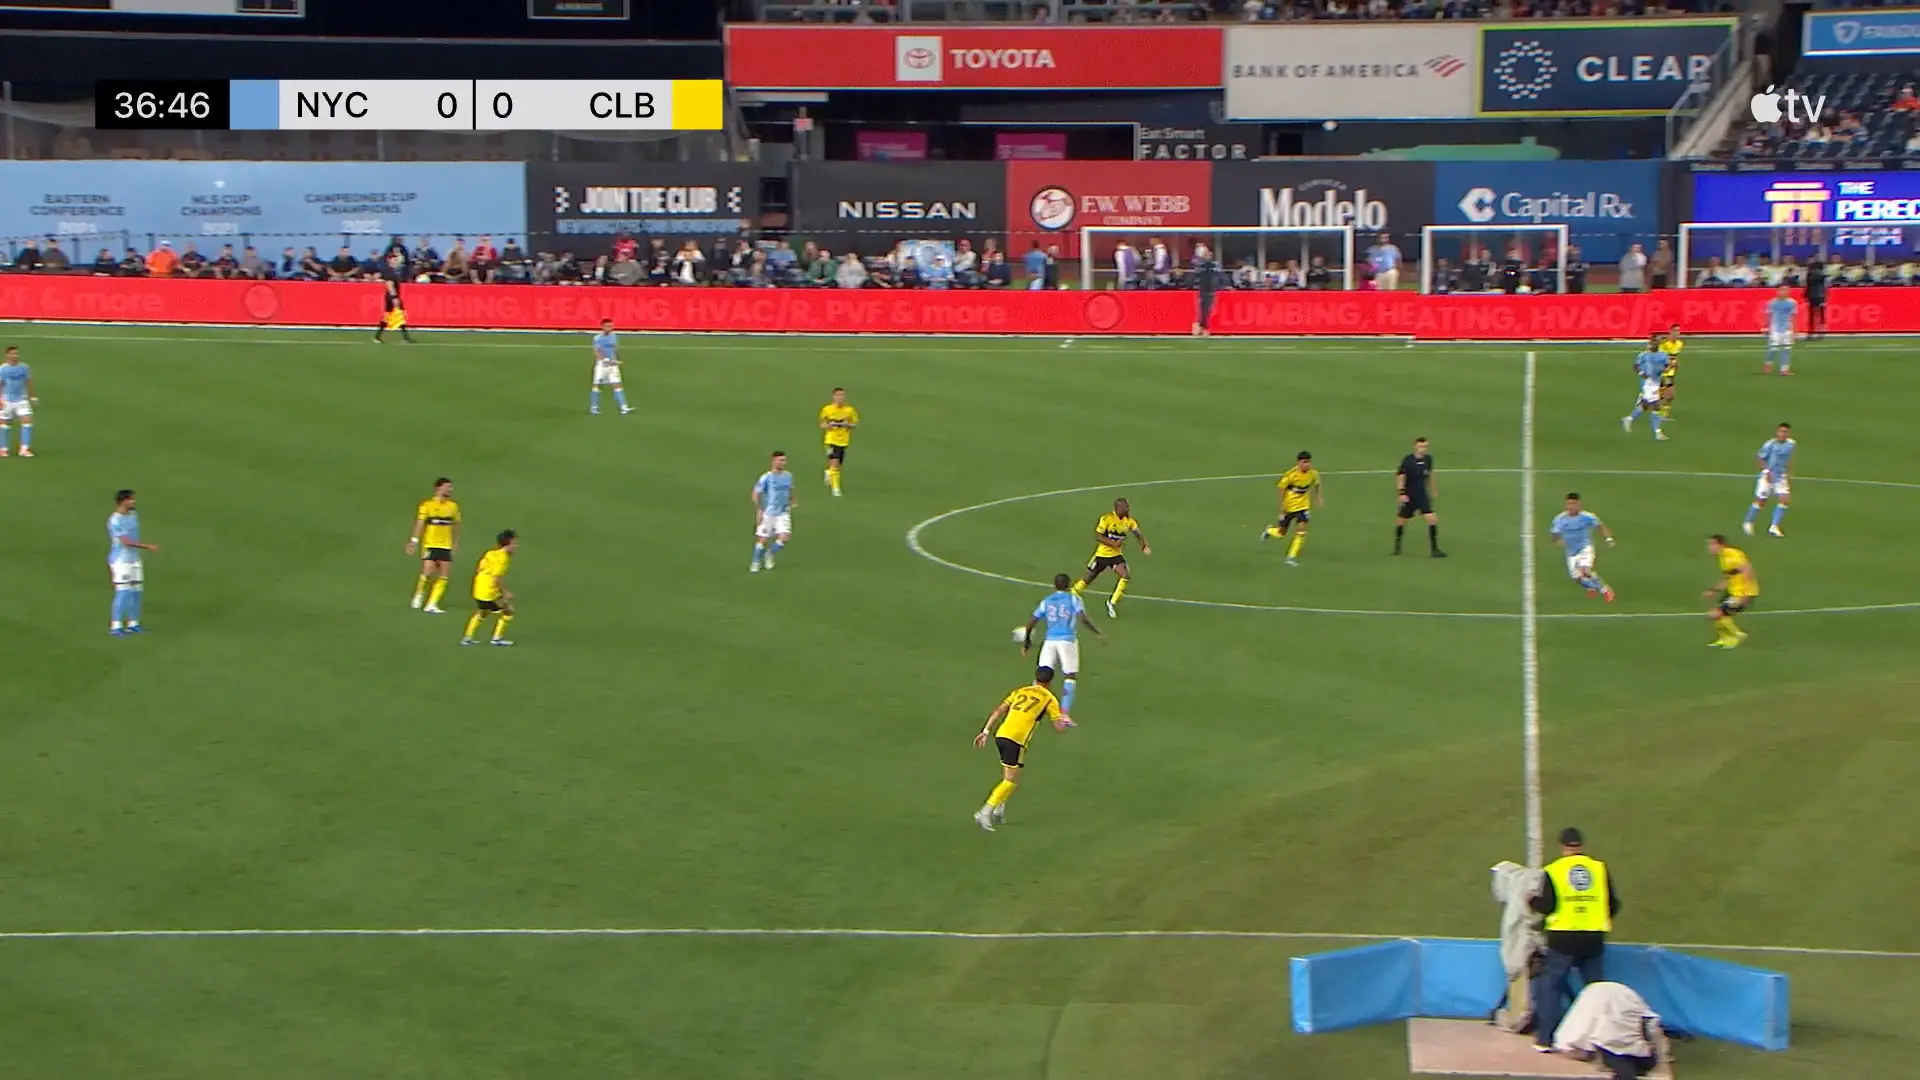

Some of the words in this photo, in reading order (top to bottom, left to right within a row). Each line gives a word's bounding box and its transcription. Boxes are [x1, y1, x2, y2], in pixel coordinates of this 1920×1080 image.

[950, 48, 1056, 69] TOYOTA
[1232, 63, 1291, 80] BANK
[1295, 63, 1322, 79] OF
[1324, 62, 1419, 79] AMERICA
[1141, 143, 1247, 160] FACTOR
[391, 192, 417, 202] CUP
[1837, 181, 1876, 195] THE
[44, 194, 110, 204] EASTERN
[580, 186, 628, 213] JOIN
[630, 187, 666, 213] THE
[667, 187, 718, 213] CLUB
[1123, 195, 1190, 213] WEBB
[1501, 191, 1596, 224] Capital
[1599, 193, 1637, 219] Rx
[29, 206, 126, 216] CONFERENCE
[181, 206, 262, 216] CHAMPIONS
[321, 204, 402, 215] CHAMPIONS
[838, 201, 977, 220] NISSAN
[1259, 187, 1388, 230] Modelo
[74, 290, 164, 314] more
[826, 299, 882, 324] PVF
[922, 303, 1007, 325] more
[1683, 299, 1746, 325] PVF
[1012, 694, 1041, 713] 27
